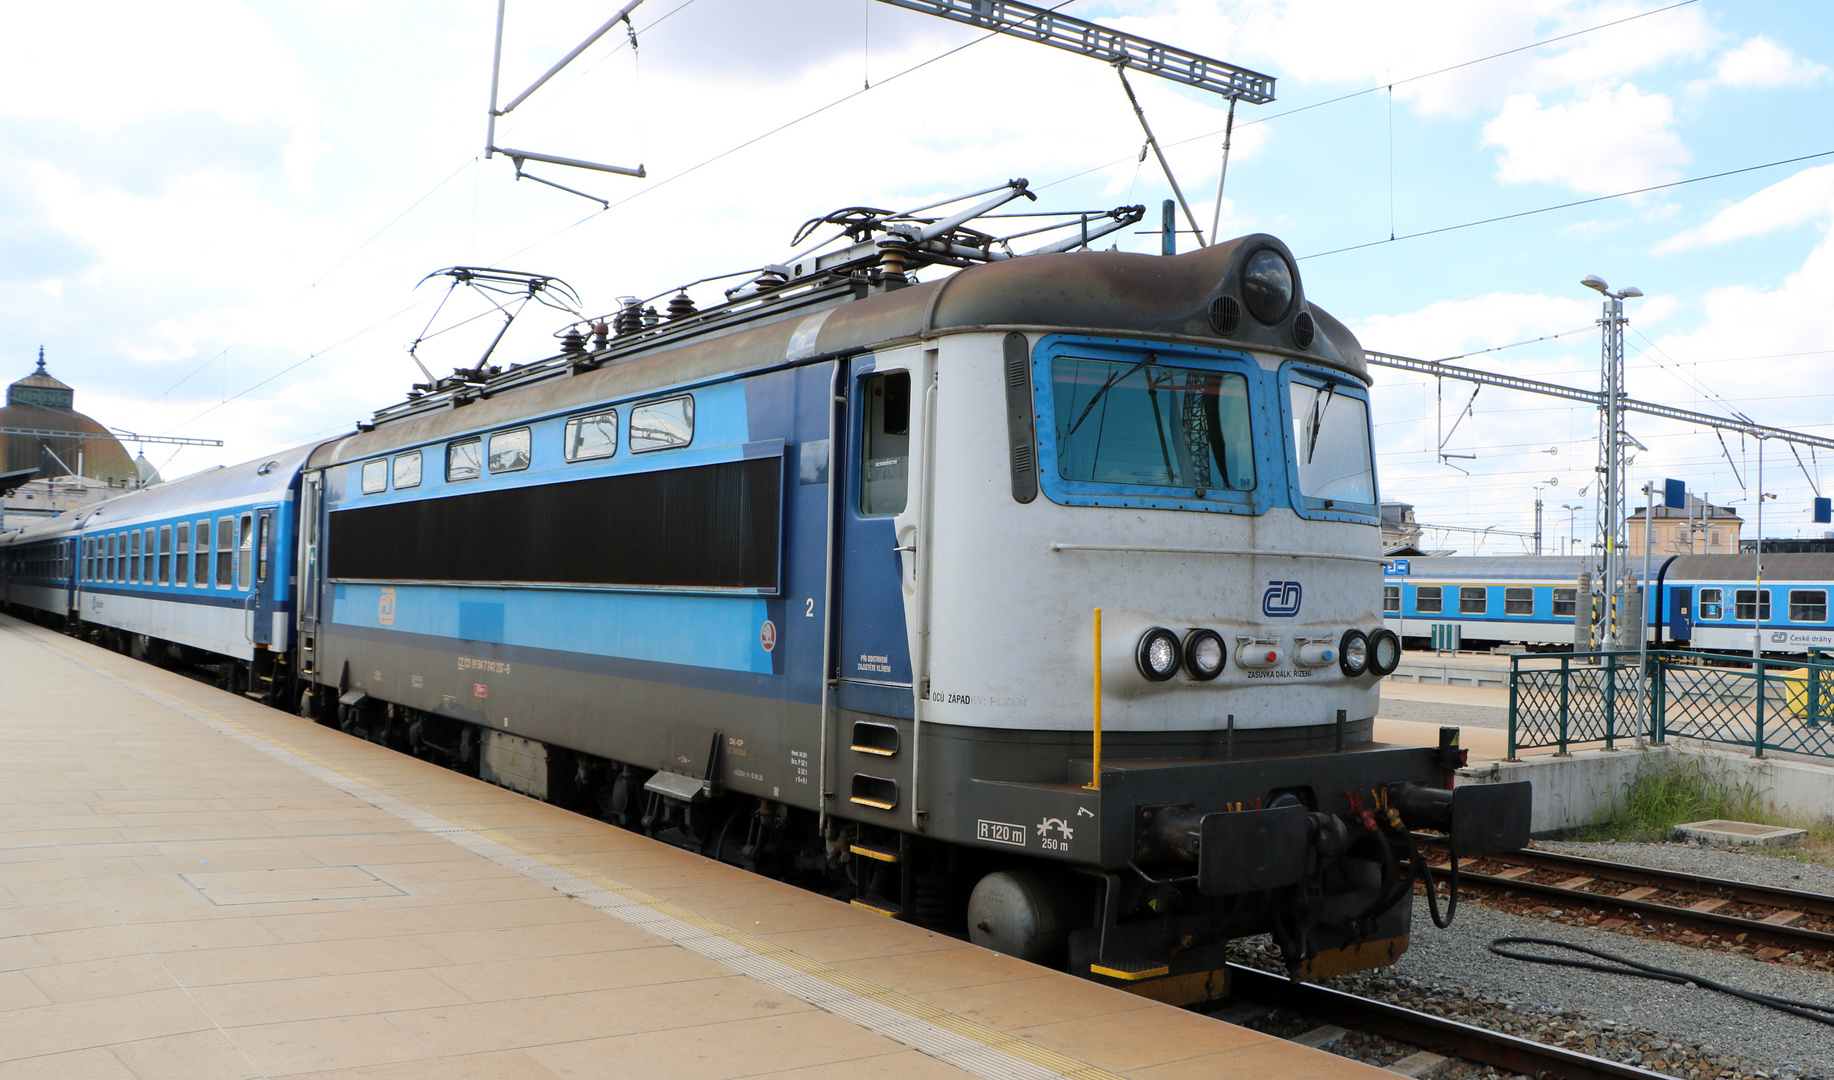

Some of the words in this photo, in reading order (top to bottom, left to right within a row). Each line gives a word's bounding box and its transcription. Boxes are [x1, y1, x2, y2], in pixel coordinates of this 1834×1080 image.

[806, 597, 814, 617] 2
[1790, 634, 1810, 642] České
[1811, 635, 1832, 643] dráhy
[932, 690, 945, 703] OCÚ
[948, 692, 971, 705] ZÁPAD
[980, 822, 989, 838] R
[991, 824, 1010, 841] 120
[1012, 830, 1023, 843] m
[1041, 837, 1058, 850] 250
[1060, 841, 1069, 852] m
